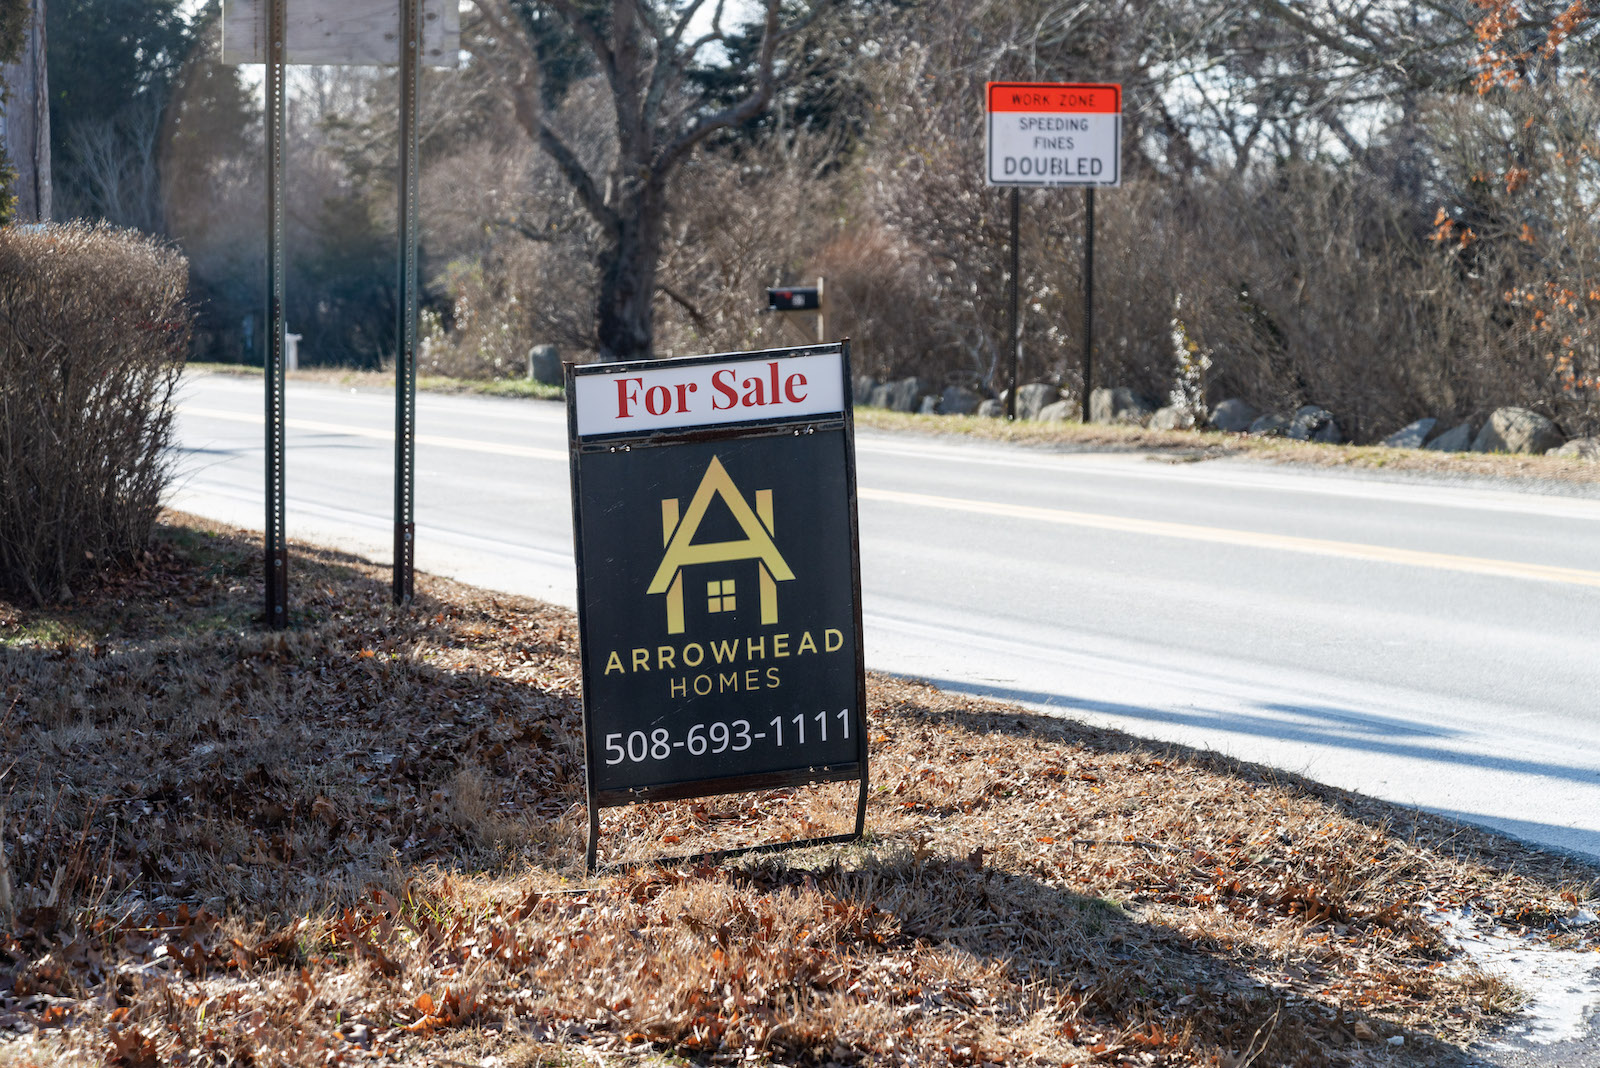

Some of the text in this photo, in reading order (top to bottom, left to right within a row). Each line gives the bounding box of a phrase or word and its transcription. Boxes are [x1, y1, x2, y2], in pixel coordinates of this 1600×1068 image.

[1012, 93, 1096, 107] WORK ZONE
[1019, 117, 1089, 131] SPEEDING
[1034, 136, 1075, 150] FINES
[1004, 156, 1103, 176] DOUBLED
[613, 362, 808, 419] For Sale
[604, 628, 844, 675] ARROWHEAD
[670, 667, 781, 698] HOMES
[605, 708, 850, 765] 508-693-1111
